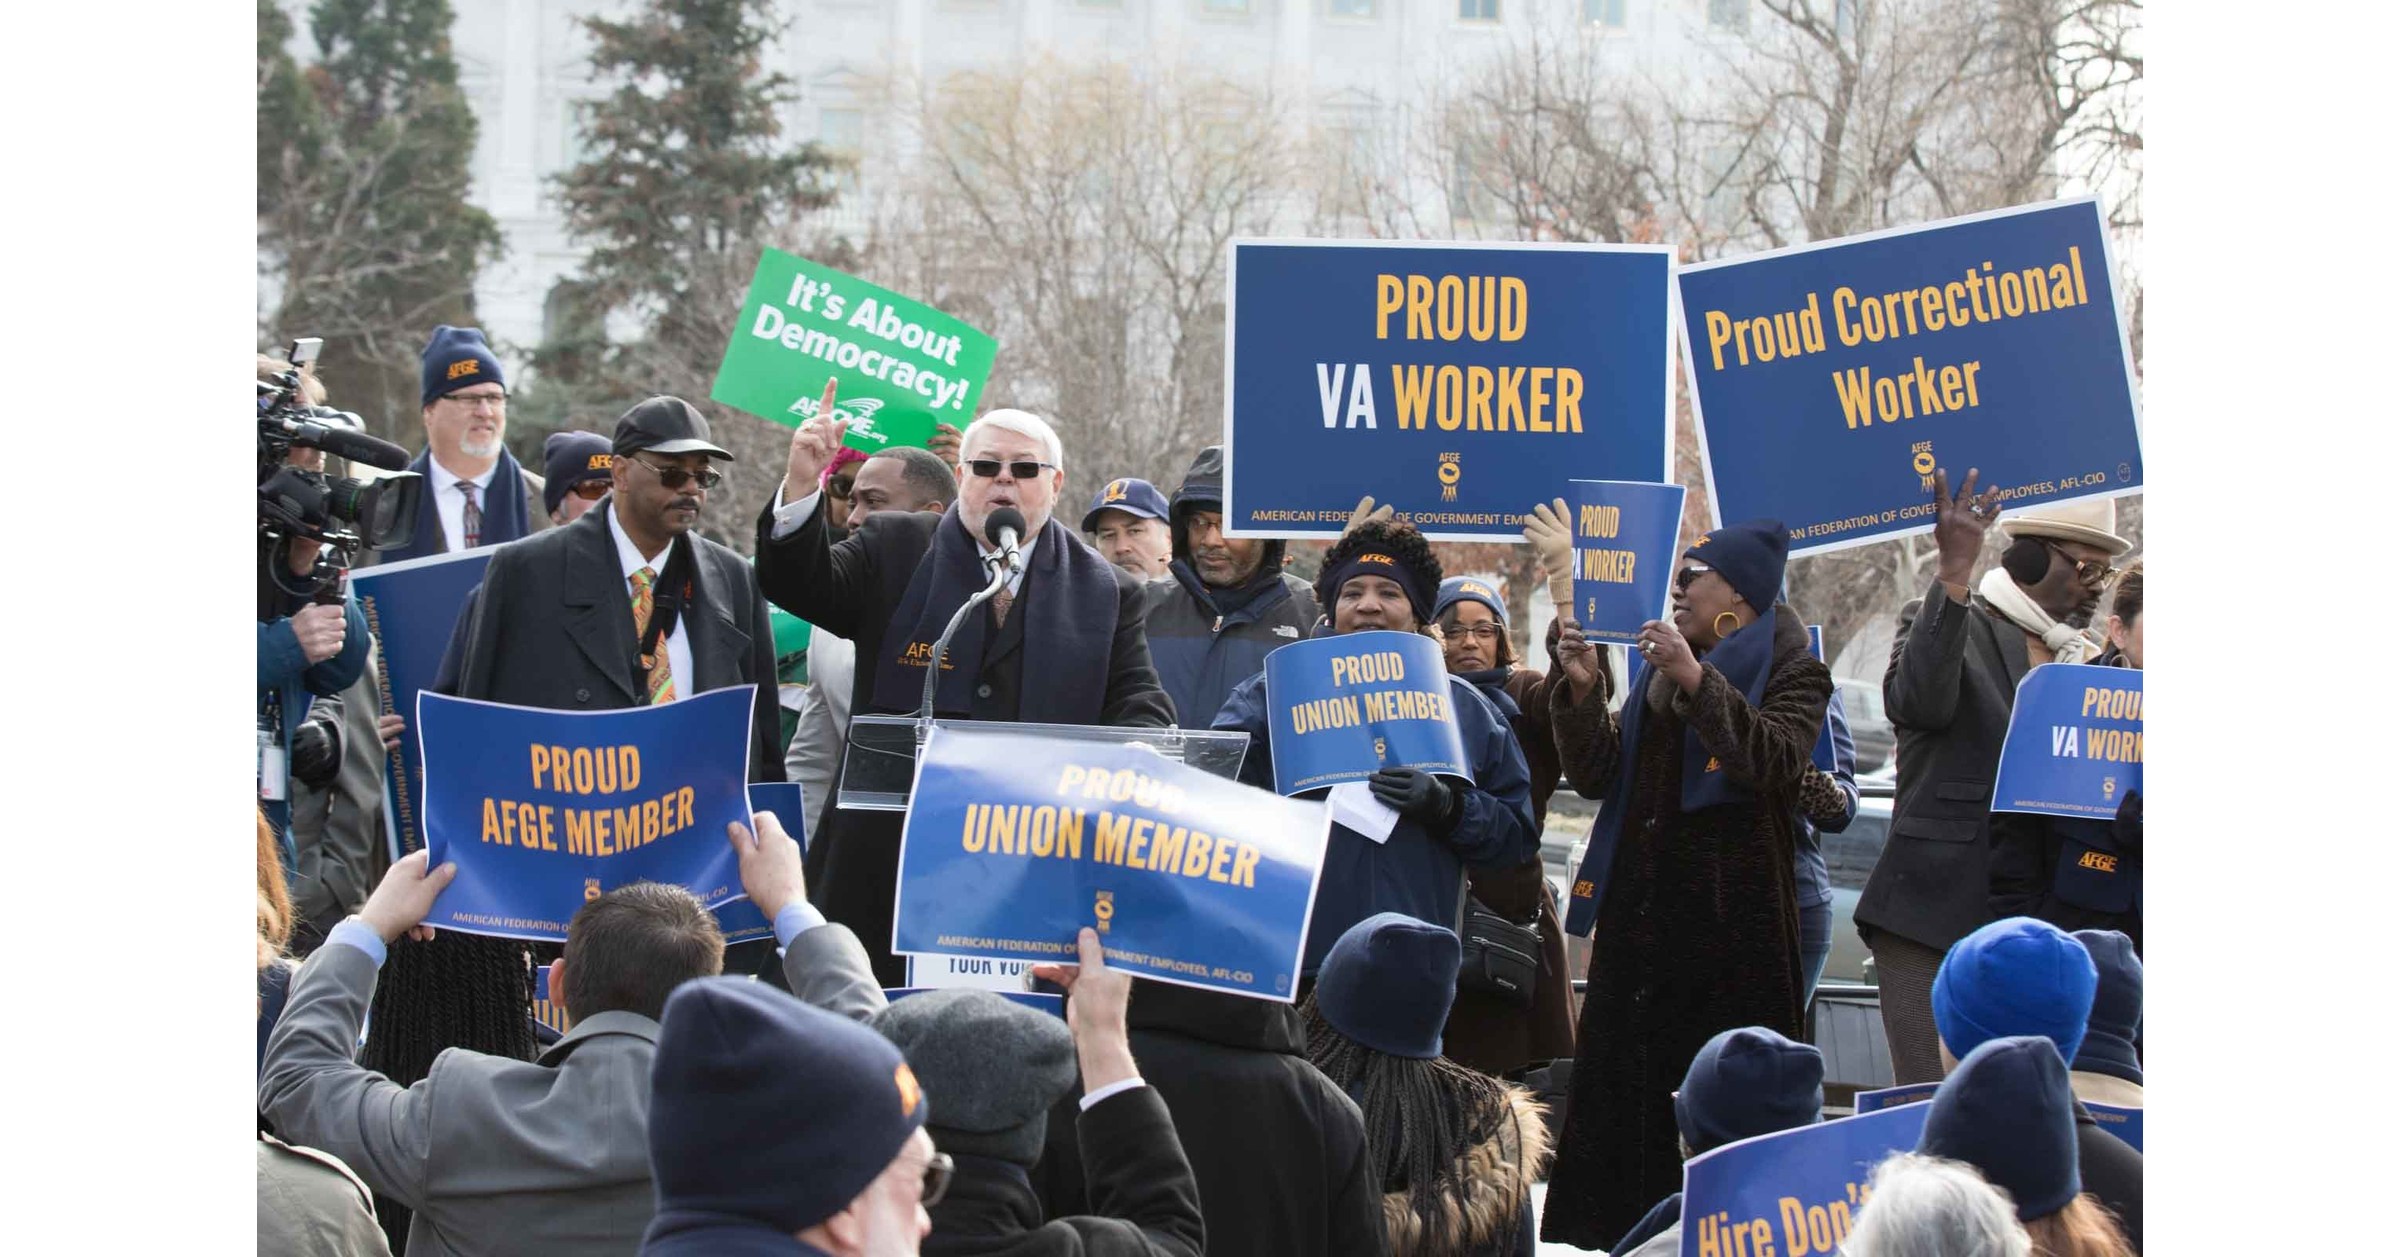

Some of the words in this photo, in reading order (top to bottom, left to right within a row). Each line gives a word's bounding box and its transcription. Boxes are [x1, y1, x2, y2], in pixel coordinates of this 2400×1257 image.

[786, 273, 846, 321] It's
[847, 298, 962, 367] About
[1376, 273, 1528, 342] PROUD
[1705, 292, 1827, 371] Proud
[1832, 245, 2089, 348] Correctional
[752, 304, 970, 410] Democracy!
[1316, 363, 1378, 429] VA
[1391, 364, 1584, 434] WORKER
[1833, 356, 1981, 429] Worker
[587, 454, 613, 470] AFG
[1439, 452, 1461, 463] AFGE
[1911, 441, 1933, 454] AFGE
[1251, 510, 1316, 522] AMERICAN
[1415, 512, 1501, 525] GOVERNMENT
[1579, 504, 1620, 539] PROUD
[1808, 514, 1879, 537] FEDERATION
[1881, 509, 1897, 523] OF
[1989, 481, 2058, 503] MPLOYEES,
[2060, 471, 2106, 490] AFL-CIO
[1584, 548, 1636, 584] WORKER
[377, 656, 395, 716] FEDERATIO
[1331, 652, 1404, 688] PROUD
[1291, 695, 1361, 735] UNION
[2082, 687, 2143, 721] PROU
[2052, 725, 2079, 758] VA
[2087, 728, 2143, 763] WORK
[530, 743, 641, 795] PROUD
[1057, 764, 1188, 814] PROUD
[482, 797, 558, 852] AFGE
[564, 785, 695, 857] MEMBER
[962, 803, 1086, 859] UNION
[1094, 811, 1260, 888] MEMBER
[2078, 851, 2119, 873] AFGE
[452, 911, 501, 926] AMERICAN
[504, 917, 560, 932] FEDERATION
[936, 935, 996, 950] AMERICAN
[997, 938, 1062, 953] FEDERATION
[1150, 957, 1210, 978] EMPLOYEES,
[1212, 967, 1253, 984] AFL-CIO
[1698, 1211, 1775, 1257] Hire
[1778, 1182, 1872, 1257] Don'
